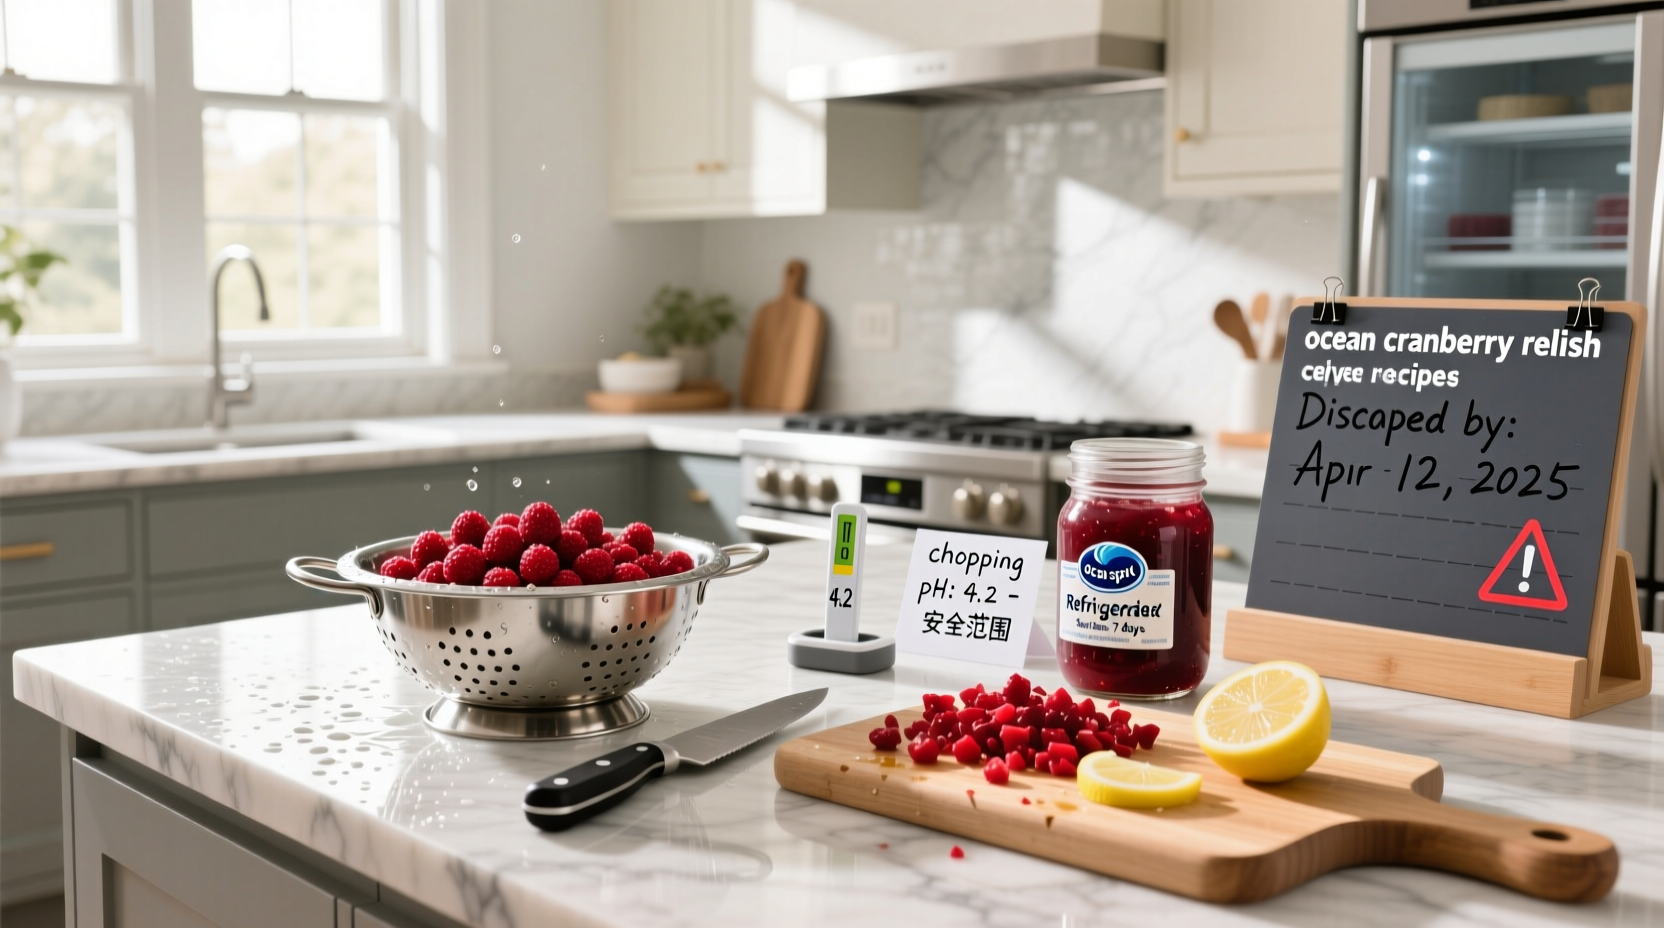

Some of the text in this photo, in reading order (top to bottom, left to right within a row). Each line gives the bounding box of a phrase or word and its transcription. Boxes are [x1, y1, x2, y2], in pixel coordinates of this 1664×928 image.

[1304, 326, 1601, 363] ocean cranberry relish
[1295, 391, 1517, 453] Discaped by:
[1469, 461, 1580, 500] 2025
[928, 541, 1024, 581] chopping
[829, 587, 853, 608] 4.2
[917, 578, 955, 605] pH:
[963, 583, 997, 604] 4.2
[922, 610, 1012, 642] 安全范围
